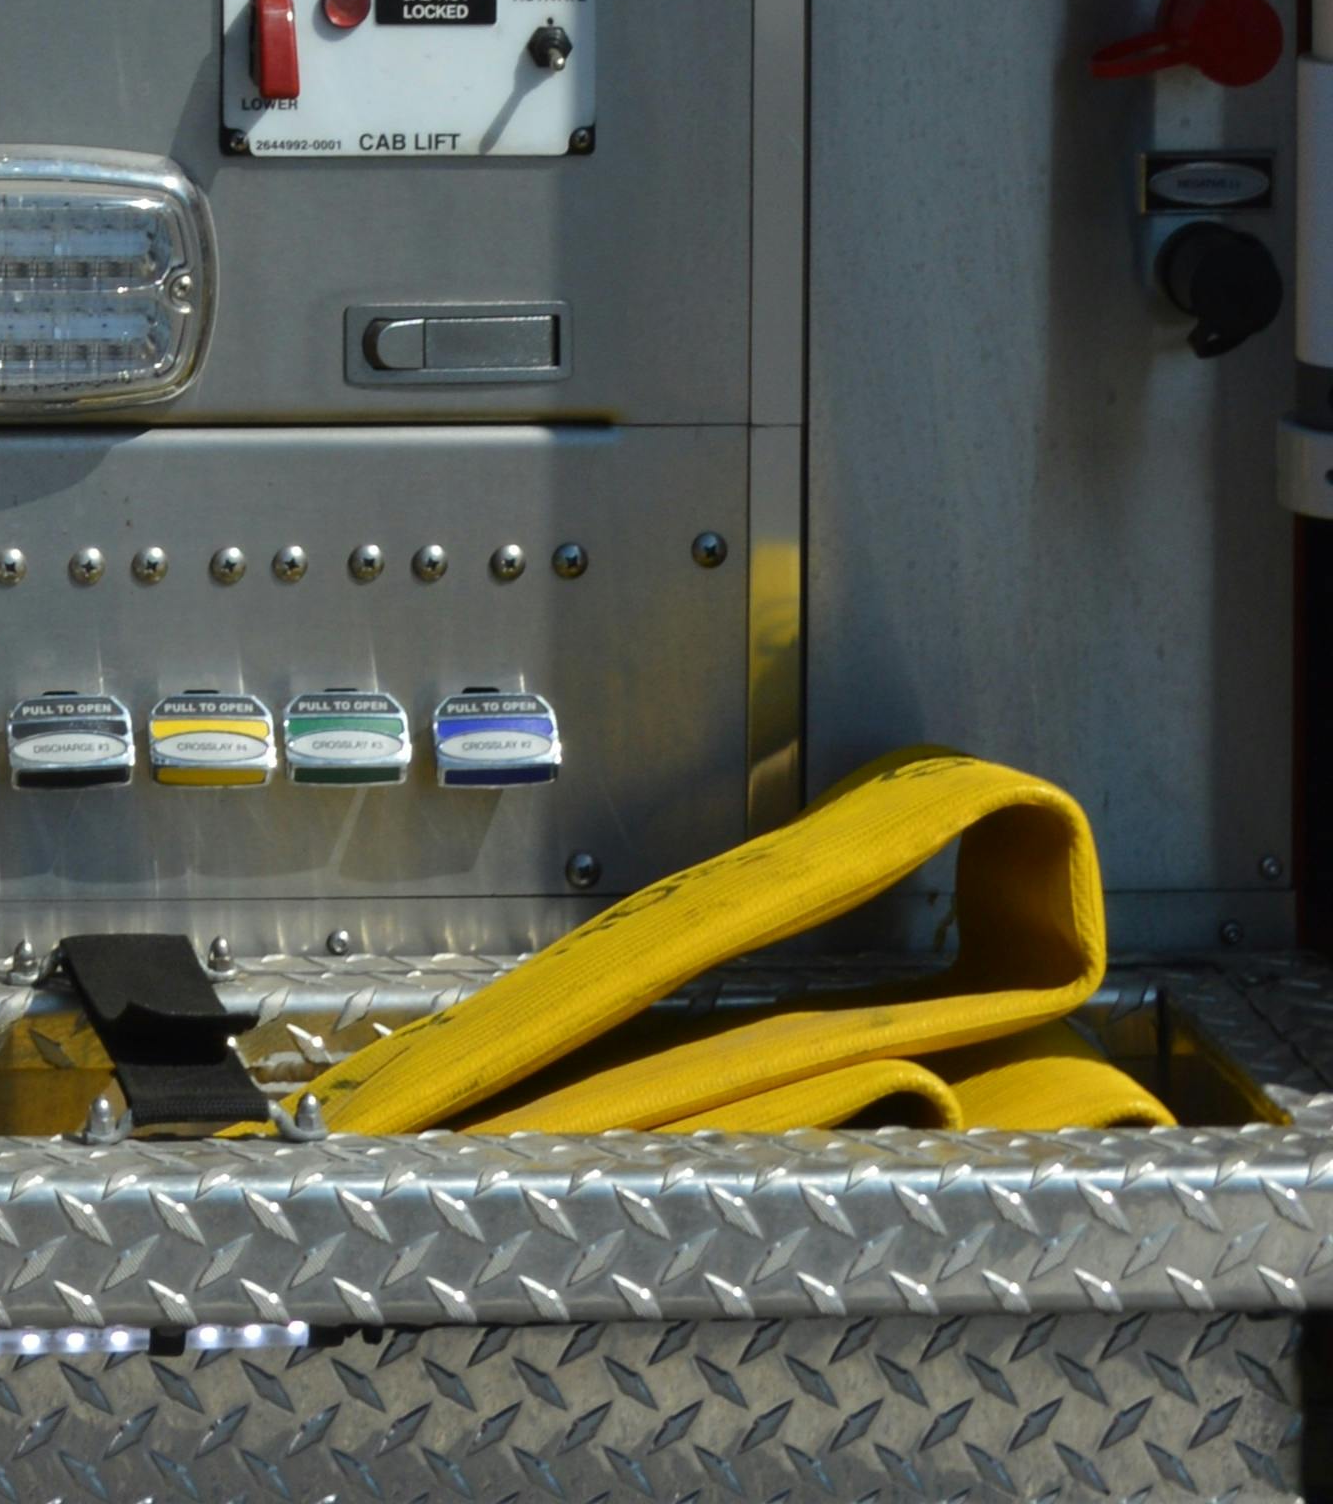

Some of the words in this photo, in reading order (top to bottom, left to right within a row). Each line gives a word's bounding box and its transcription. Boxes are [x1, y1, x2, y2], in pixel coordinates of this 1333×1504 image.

[403, 4, 469, 19] LOCKED
[242, 98, 298, 111] LOWER
[256, 139, 342, 150] 2644992-0001
[358, 134, 408, 151] CAB
[413, 133, 461, 150] LIFT
[22, 705, 54, 715] PULL
[59, 705, 74, 715] TO
[77, 704, 112, 714] OPEN
[164, 703, 196, 713] PULL
[200, 703, 215, 713] TO
[219, 703, 254, 713] OPEN
[298, 702, 330, 712] PULL
[334, 701, 350, 711] TO
[354, 701, 388, 711] OPEN
[447, 703, 480, 713] PULL
[481, 702, 499, 712] TO
[502, 702, 537, 712] OPEN
[34, 744, 93, 754] DISCHARGE
[98, 743, 110, 752] #3
[176, 742, 233, 752] CROSSLAY
[236, 743, 248, 752] #4
[312, 740, 368, 750] CROSSLAY
[371, 740, 383, 749] #3
[462, 741, 518, 751] CROSSLAY
[521, 740, 532, 749] #2
